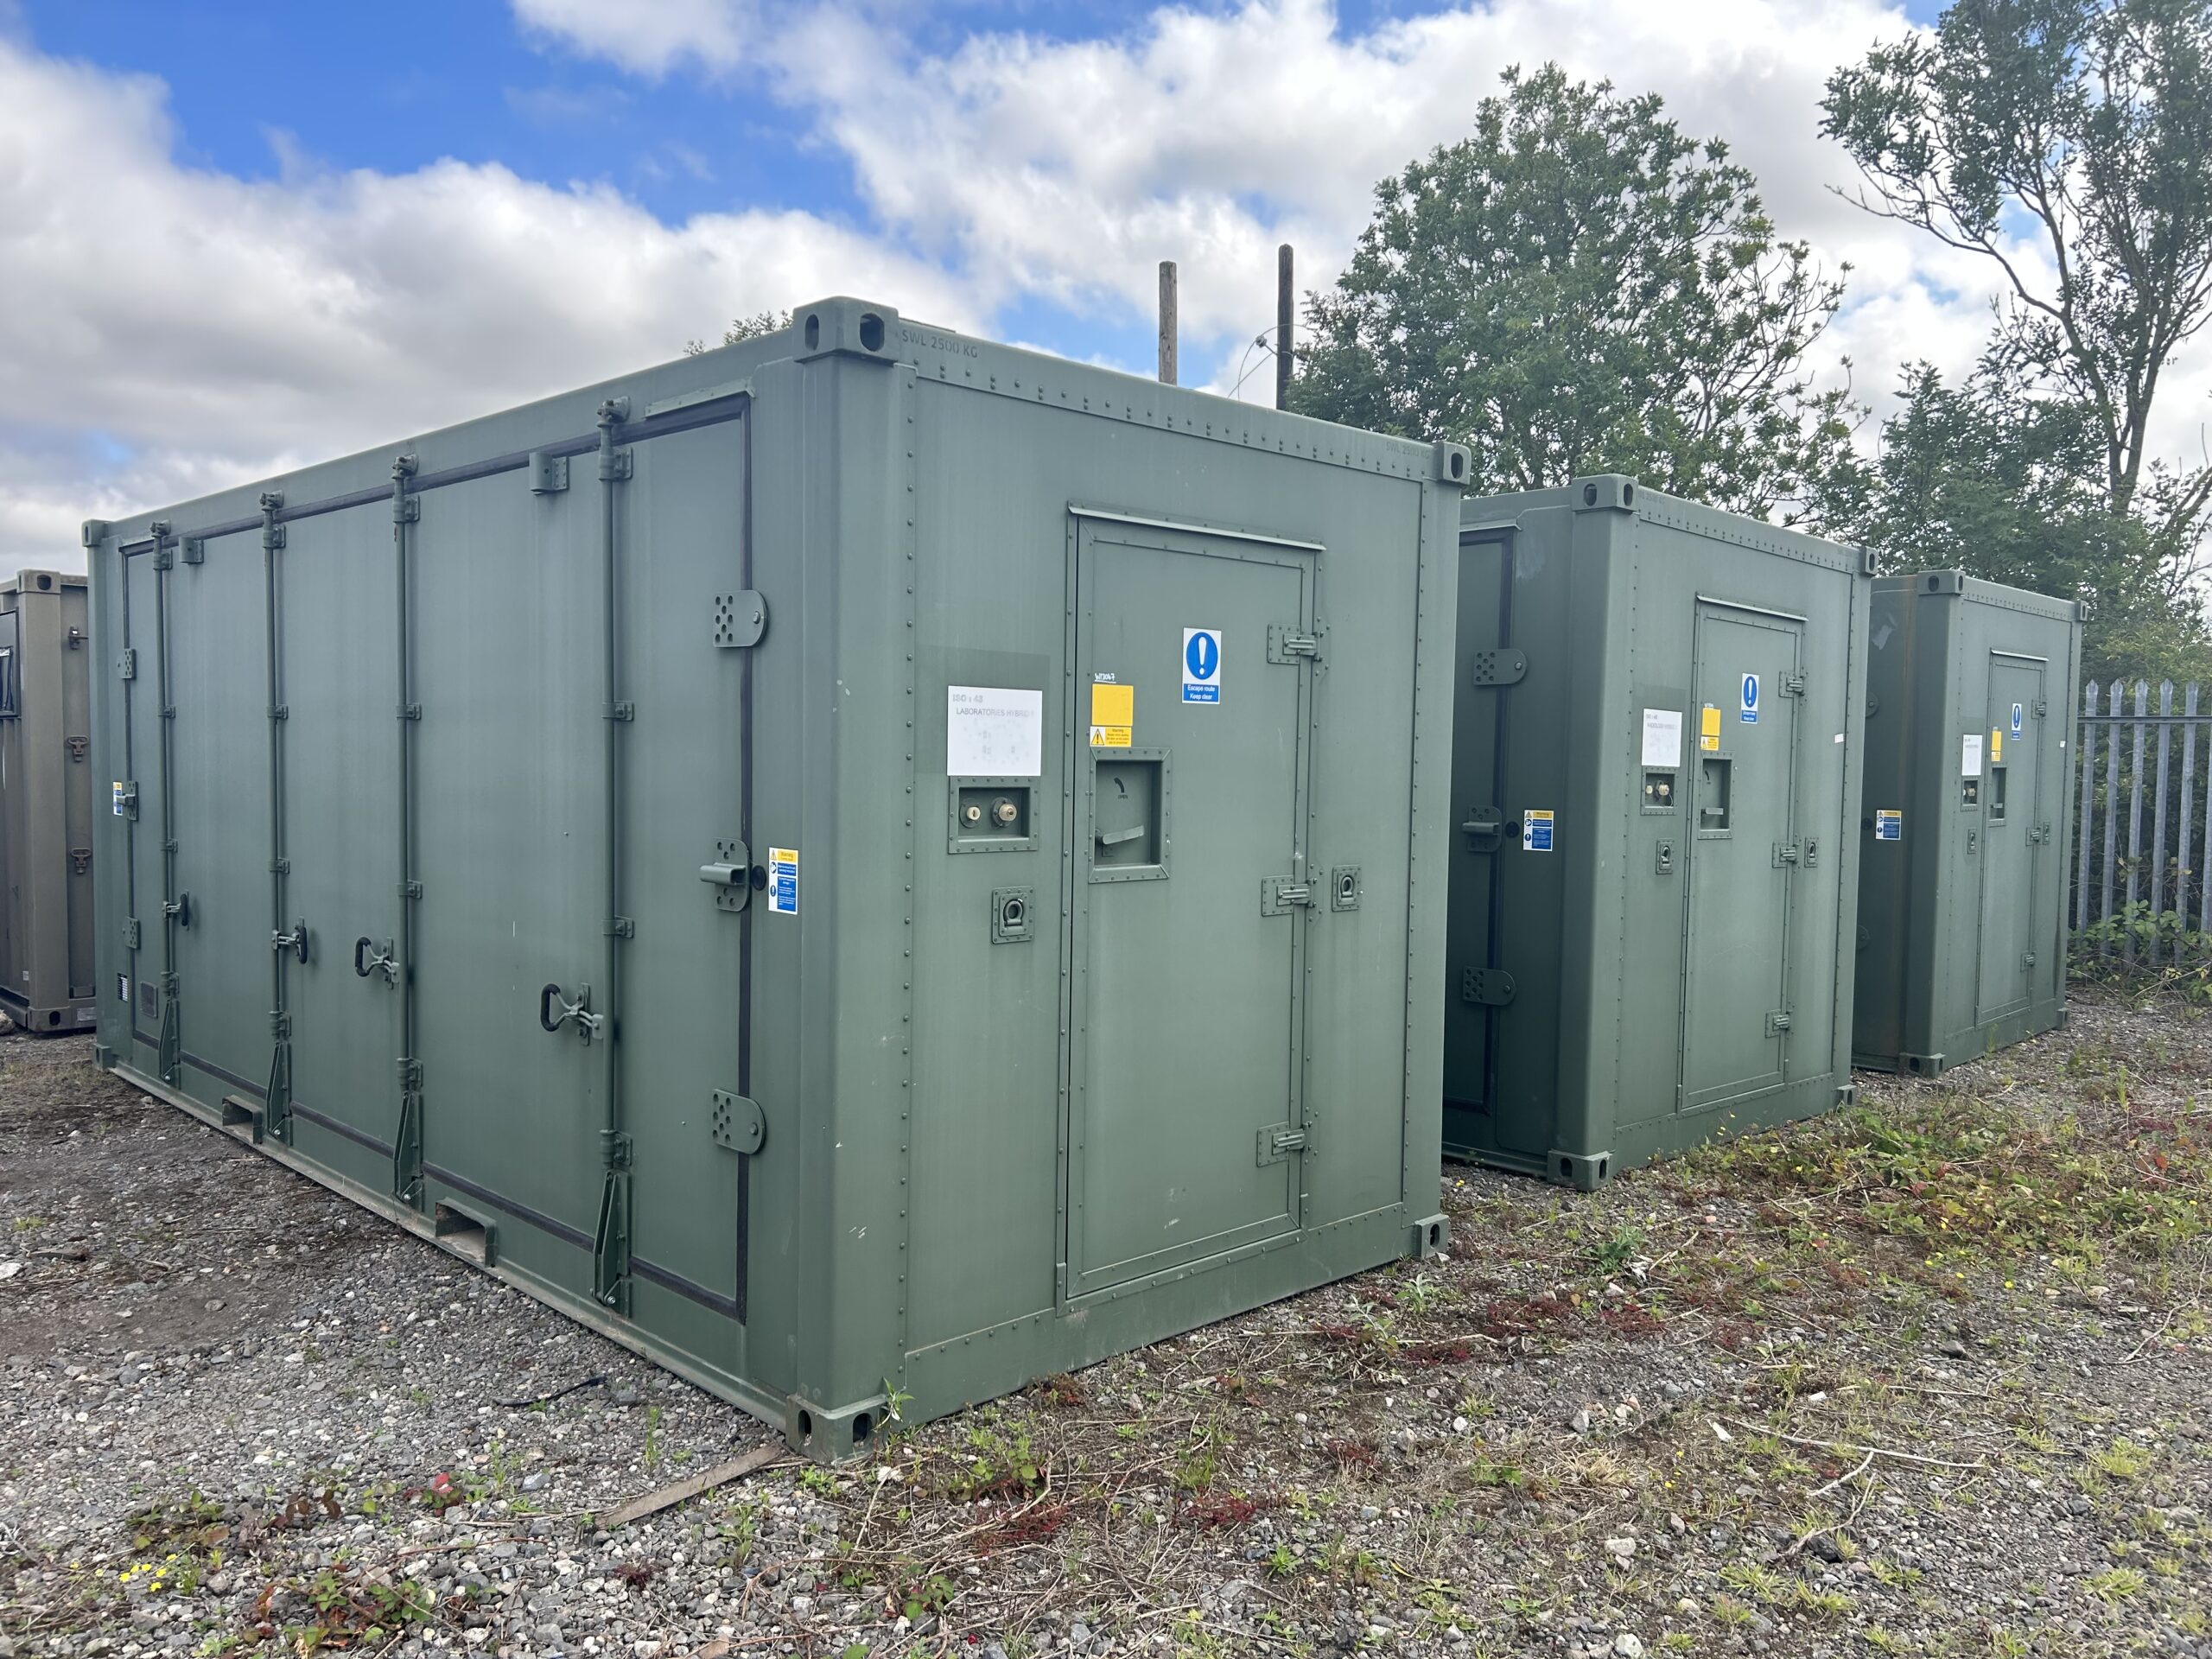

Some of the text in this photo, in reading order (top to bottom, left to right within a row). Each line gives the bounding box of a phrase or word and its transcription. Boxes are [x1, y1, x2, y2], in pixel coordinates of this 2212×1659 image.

[902, 329, 977, 358] SWL 2500 KG
[952, 694, 967, 702] ISO
[956, 708, 1005, 717] LABORATORIES
